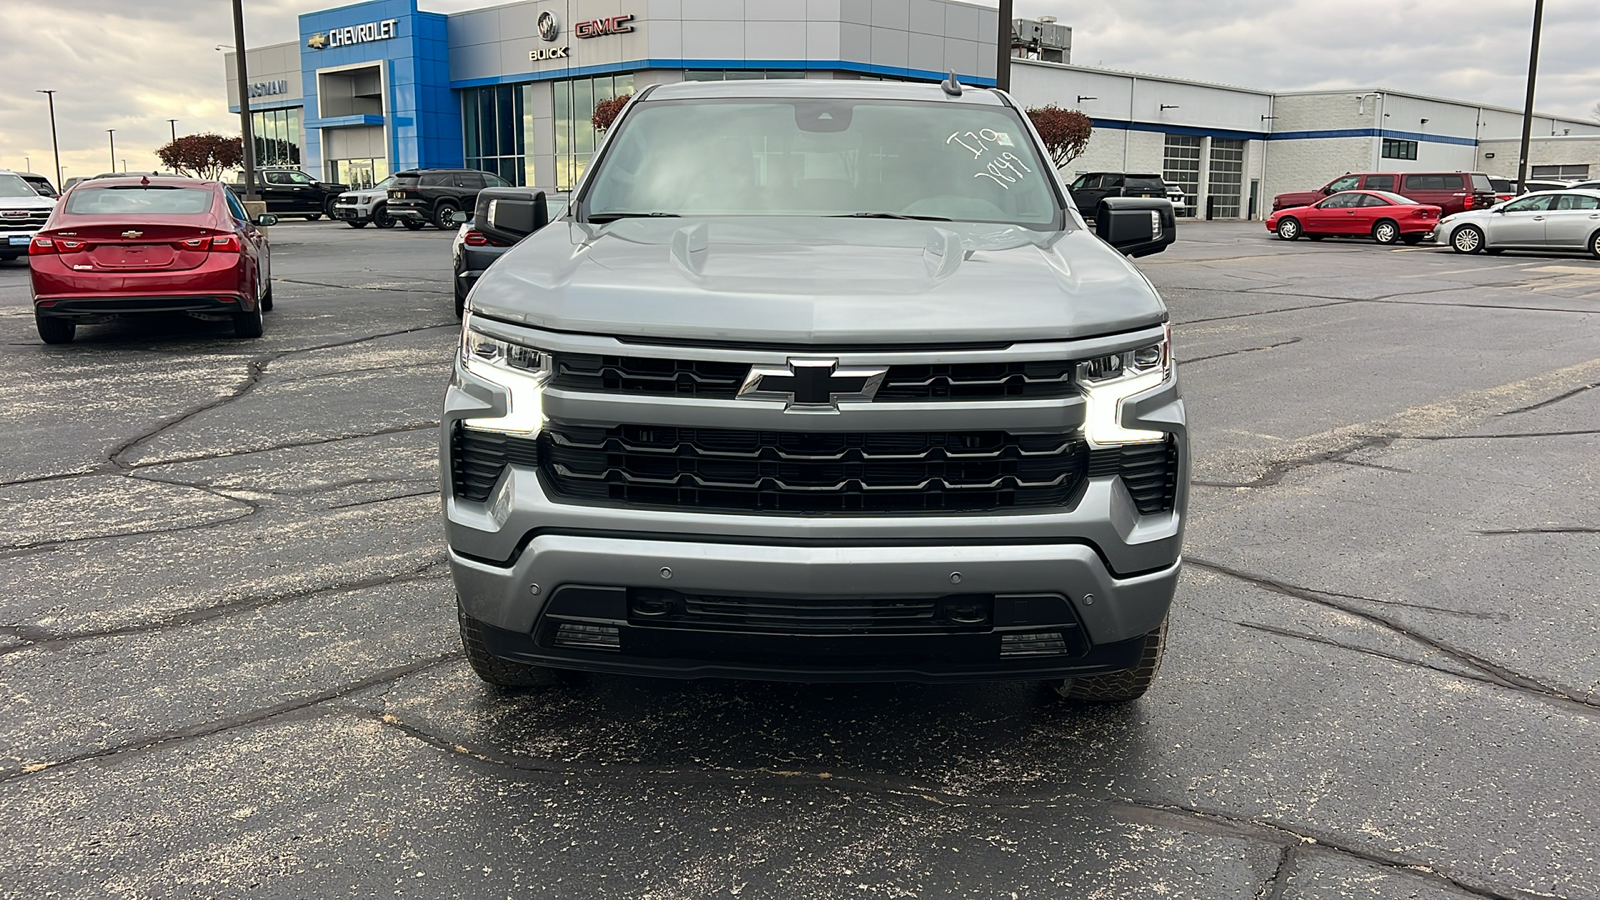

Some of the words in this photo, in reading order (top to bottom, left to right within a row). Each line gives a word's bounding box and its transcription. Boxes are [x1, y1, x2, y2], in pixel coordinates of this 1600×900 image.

[329, 19, 397, 47] CHEVROLET
[575, 14, 633, 38] GMC
[529, 47, 568, 61] BUICK
